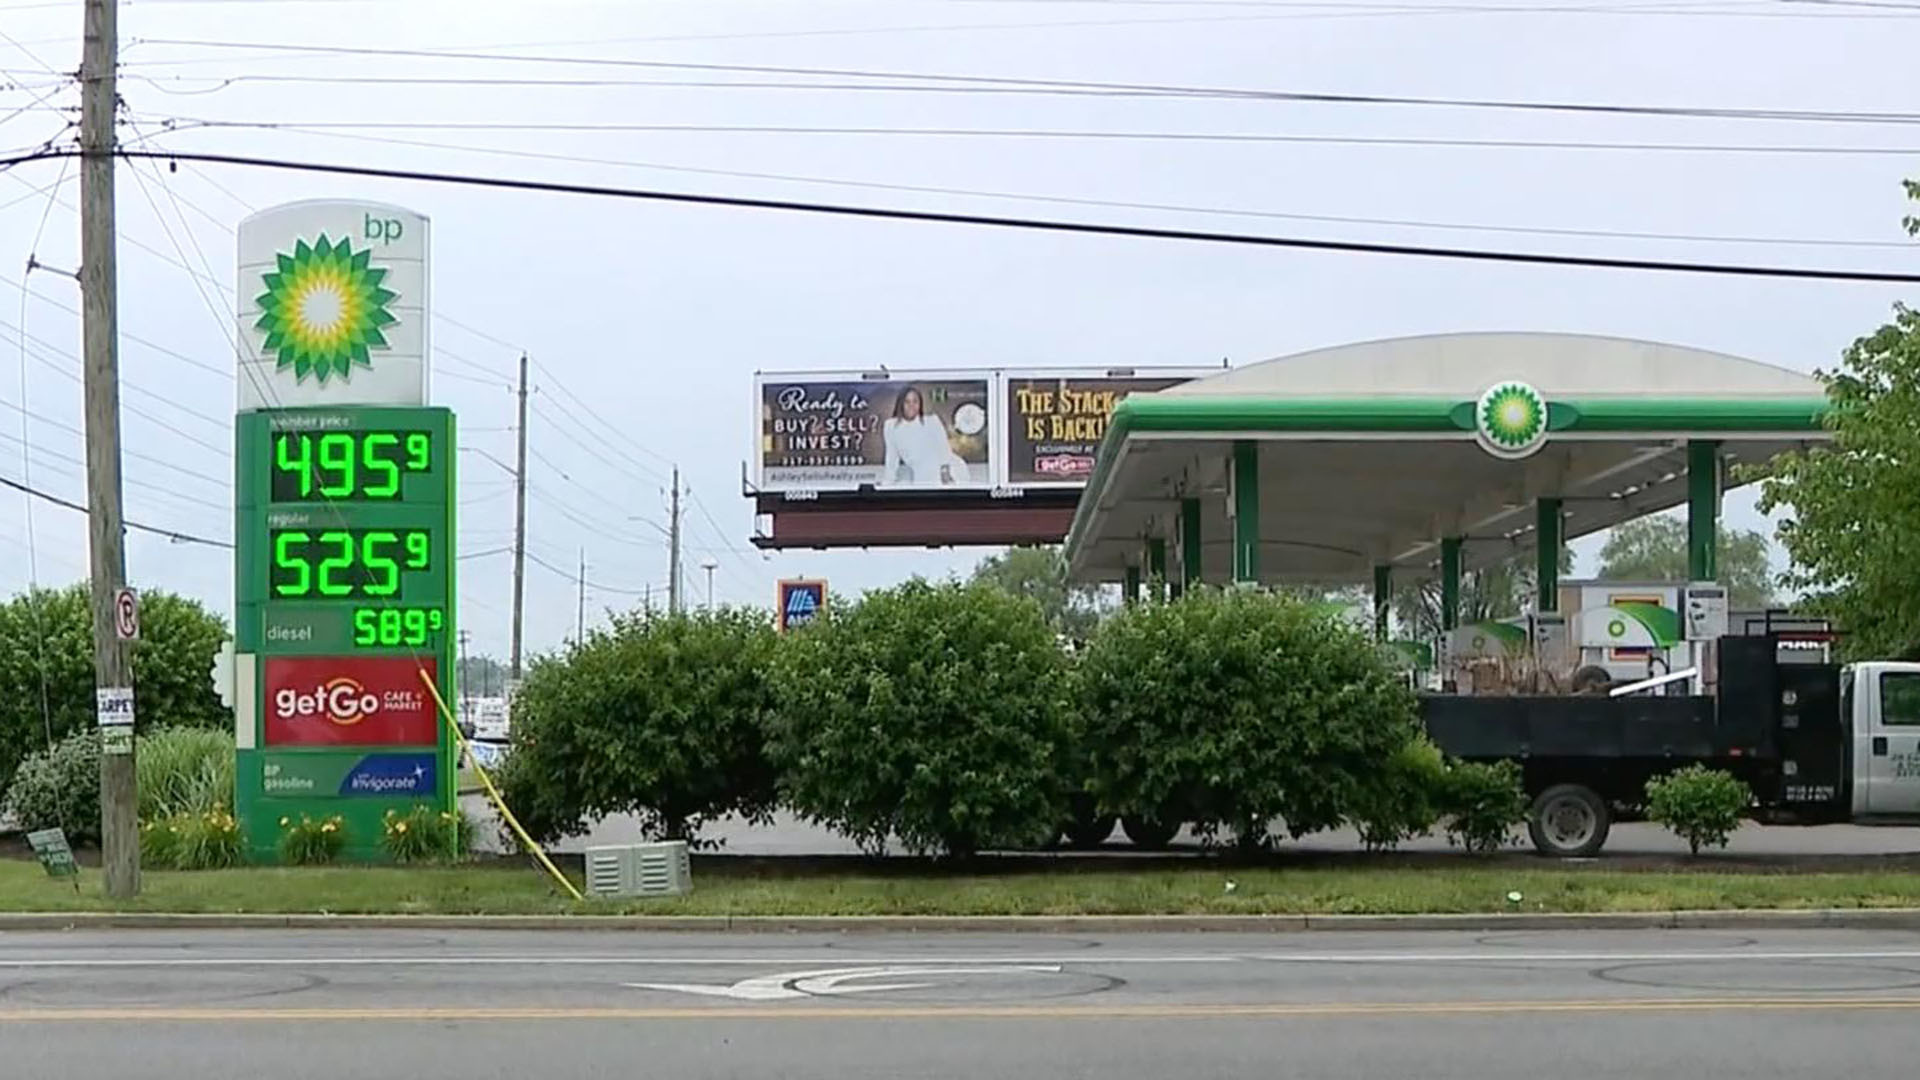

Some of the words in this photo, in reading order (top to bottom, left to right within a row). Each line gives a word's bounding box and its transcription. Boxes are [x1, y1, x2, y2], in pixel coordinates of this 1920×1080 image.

[364, 213, 402, 244] bp
[778, 387, 844, 418] Ready
[850, 393, 868, 409] to
[1016, 389, 1053, 414] THE
[320, 416, 349, 429] price
[775, 416, 818, 434] BUY?
[826, 415, 879, 433] SELL?
[1027, 417, 1044, 440] IS
[1052, 415, 1103, 442] BACK!
[788, 433, 863, 450] INVEST?
[267, 514, 309, 526] regular
[267, 627, 311, 640] diesel
[276, 684, 379, 718] getGo
[384, 691, 412, 701] CAFE
[384, 702, 422, 710] MARKET
[264, 765, 281, 776] BP
[264, 777, 313, 790] gasoline
[351, 776, 416, 791] invigorate
